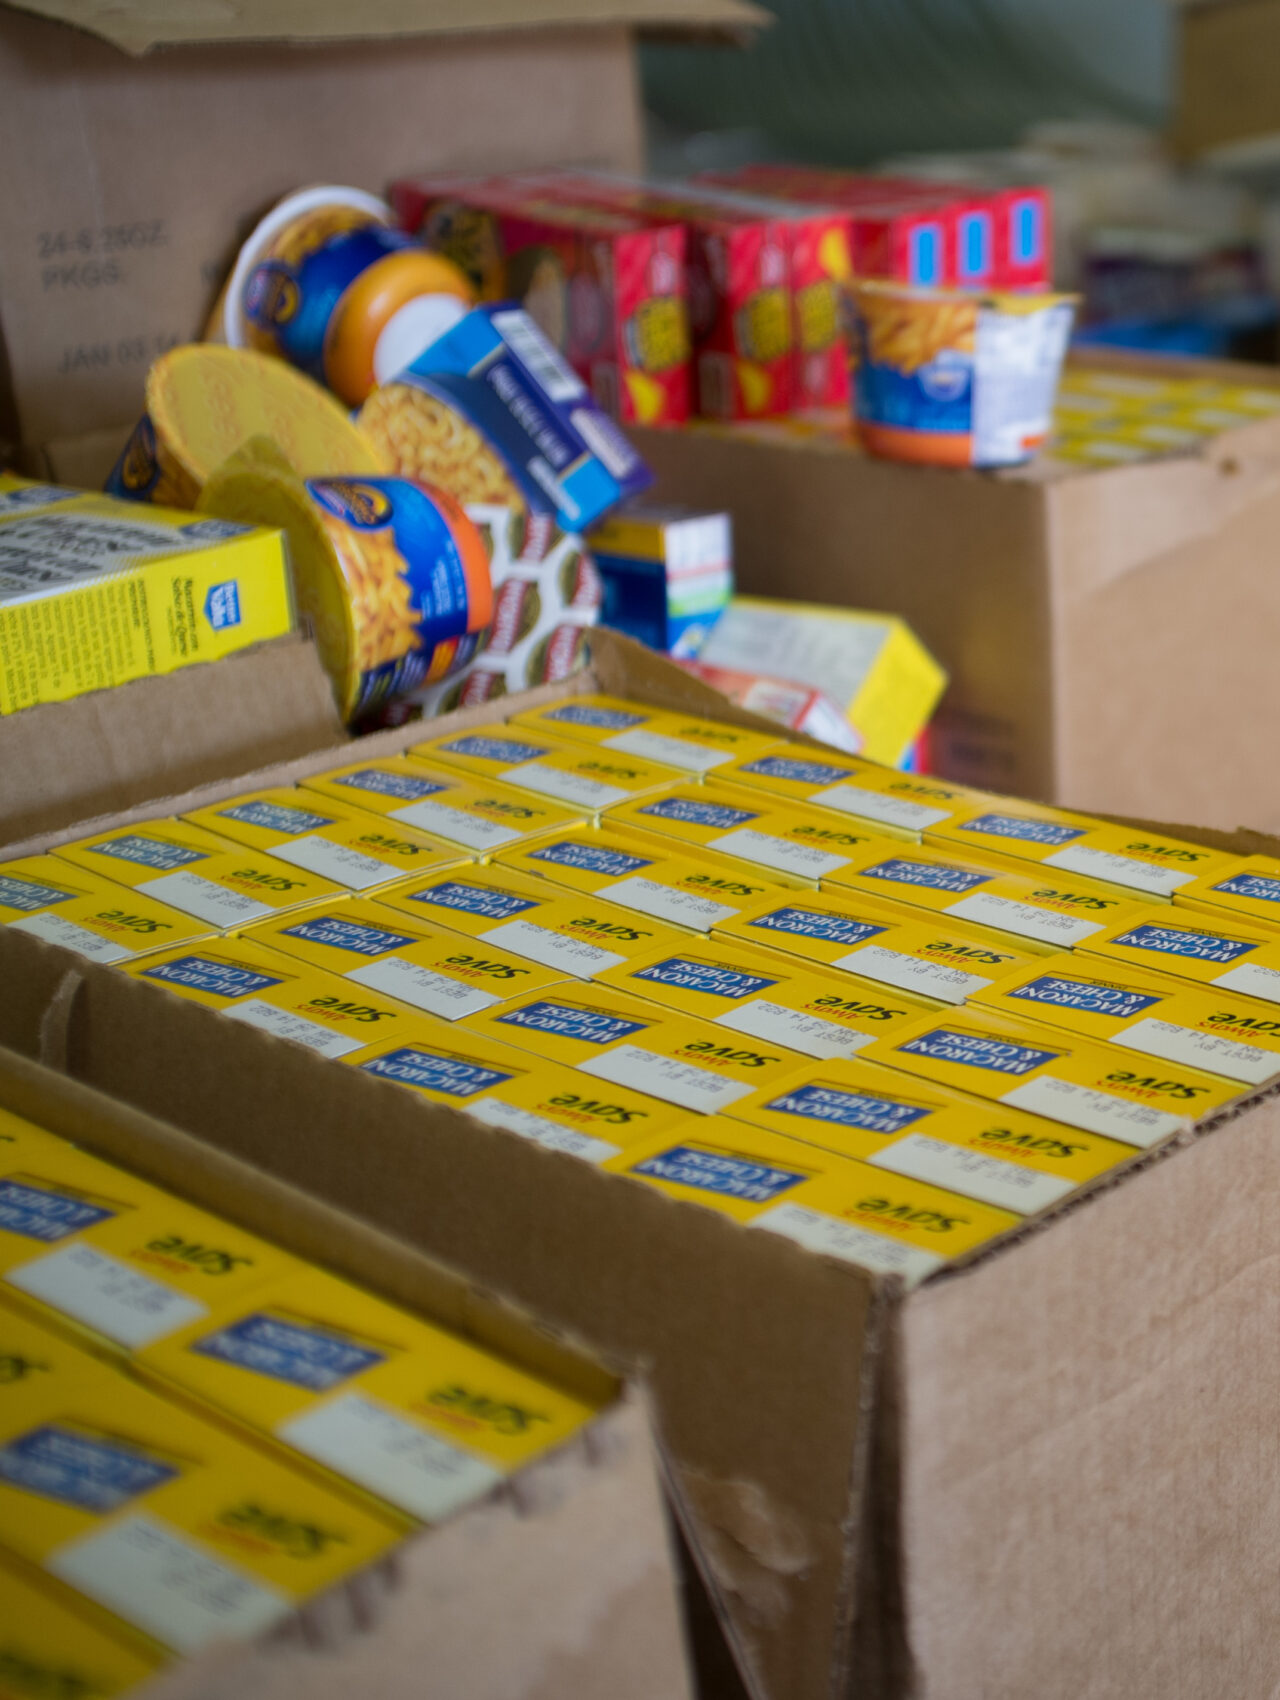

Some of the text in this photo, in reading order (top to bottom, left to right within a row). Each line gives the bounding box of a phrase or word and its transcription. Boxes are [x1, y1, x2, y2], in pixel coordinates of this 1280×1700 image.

[91, 841, 183, 868] MACARONI
[121, 837, 196, 859] & CHEESE
[532, 848, 631, 874] MACARONI
[559, 844, 640, 866] & CHEESE
[230, 869, 306, 891] Save
[684, 874, 765, 895] Save
[863, 866, 972, 891] MACARONI
[890, 862, 978, 882] & CHEESE
[413, 888, 515, 917] MACARONI
[442, 885, 525, 908] & CHEESE
[1031, 889, 1119, 909] Save
[95, 910, 173, 933] Save
[317, 920, 402, 944] & CHEESE
[569, 917, 652, 940] Save
[753, 915, 864, 943] MACARONI
[782, 910, 872, 933] & CHEESE
[285, 923, 390, 954] MACARONI
[1116, 933, 1237, 961] MACARONI
[1144, 928, 1242, 950] & CHEESE
[924, 941, 1014, 964] Save
[180, 959, 268, 985] & CHEESE
[444, 954, 529, 978] Save
[668, 961, 761, 986] & CHEESE
[147, 964, 253, 996] MACARONI
[410, 976, 472, 999] BEST BY
[637, 966, 752, 997] MACARONI
[1043, 980, 1144, 1004] & CHEESE
[308, 996, 396, 1022] Save
[813, 996, 906, 1020] Save
[1013, 985, 1138, 1015] MACARONI
[501, 1009, 620, 1042] MACARONI
[534, 1005, 630, 1030] & CHEESE
[788, 1022, 854, 1044] BEST BY
[683, 1041, 780, 1067] Save
[903, 1038, 1034, 1072] MACARONI
[935, 1033, 1041, 1060] & CHEESE
[362, 1057, 483, 1094] MACARONI
[396, 1052, 495, 1081] & CHEESE
[1105, 1071, 1210, 1099] Save
[548, 1094, 648, 1124] Save
[770, 1095, 905, 1131] MACARONI
[804, 1089, 913, 1117] & CHEESE
[979, 1128, 1088, 1157] Save
